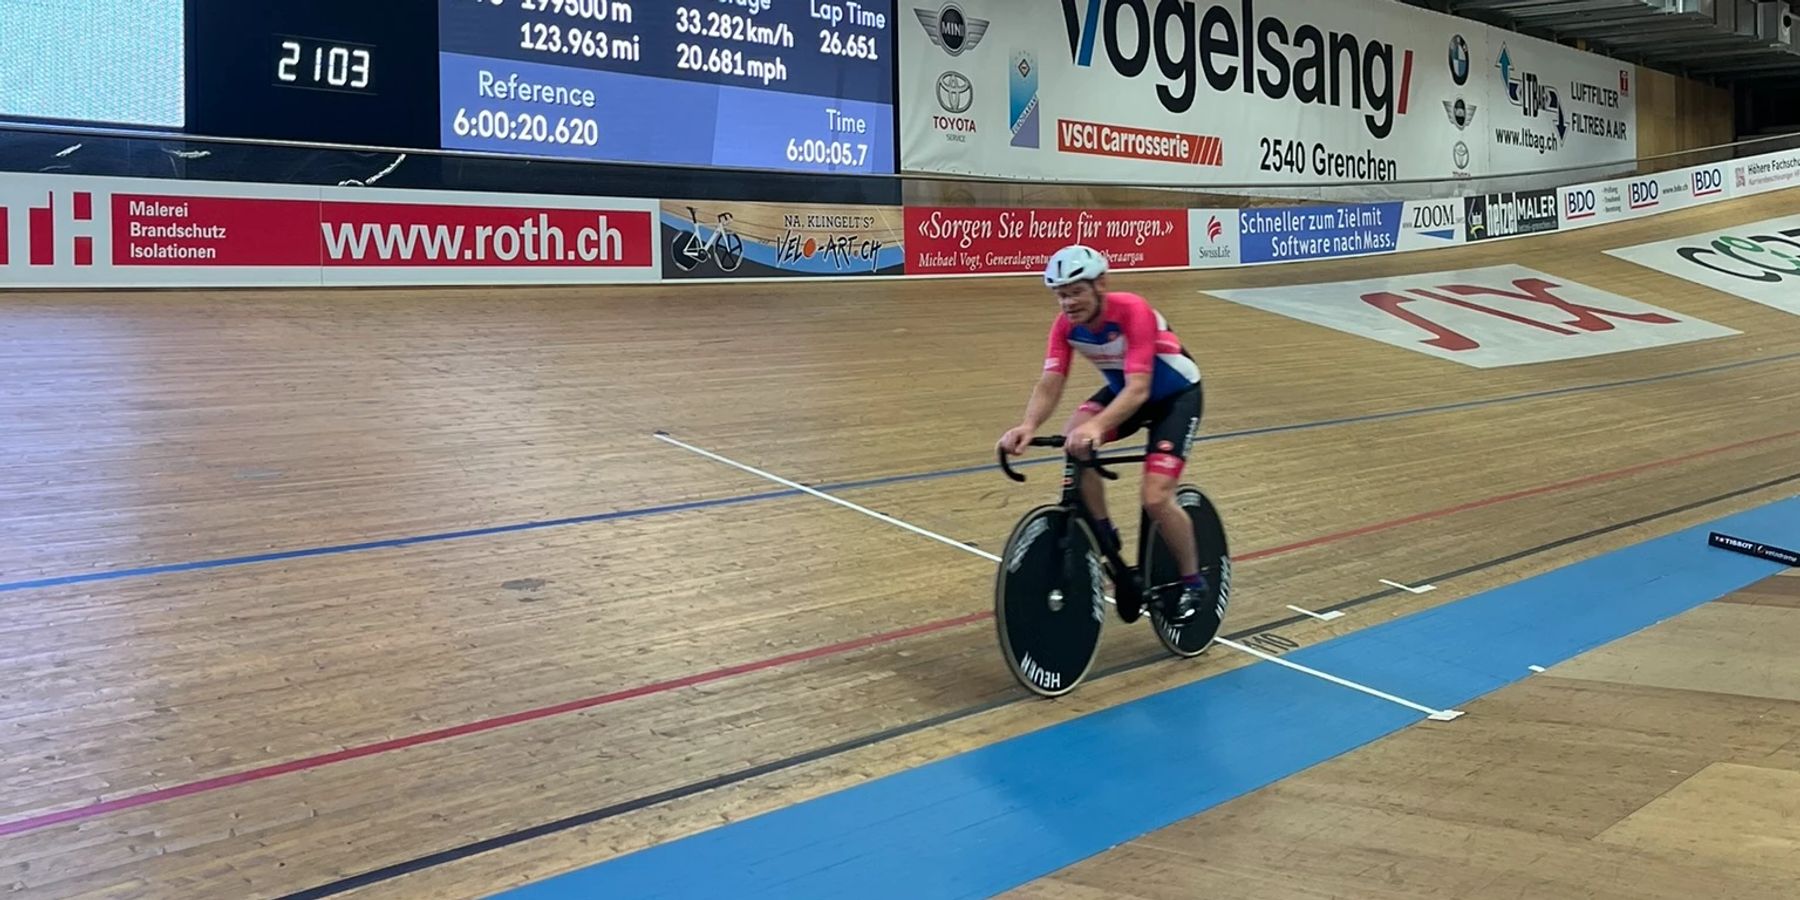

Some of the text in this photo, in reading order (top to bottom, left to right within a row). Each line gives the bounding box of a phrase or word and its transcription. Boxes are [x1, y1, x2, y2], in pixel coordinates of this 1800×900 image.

[612, 2, 632, 23] m
[810, 0, 886, 29] Lap Time
[676, 7, 744, 41] 33.282
[746, 18, 794, 48] km/h
[520, 22, 640, 62] 123.963 mi
[819, 29, 878, 60] 26.651
[278, 41, 370, 88] 2103
[676, 43, 787, 85] 20.681 mph
[1061, 0, 1395, 139] Vogelsang
[479, 70, 596, 107] Reference
[1570, 81, 1619, 109] LUFTFILTER
[453, 107, 598, 146] 6:00:20.620
[825, 108, 867, 133] Time
[933, 115, 977, 133] TOYOTA
[1571, 112, 1605, 137] FILTRES
[786, 138, 868, 166] 6:00:05.7
[1061, 122, 1189, 159] VSCI Carrosserie
[1495, 127, 1558, 154] www.ltbag.ch
[1260, 137, 1397, 181] 2540 Grenchen
[1631, 180, 1659, 203] BDO
[1695, 168, 1722, 191] BDO
[129, 201, 188, 217] Malerei
[1517, 195, 1556, 220] MALER
[1568, 189, 1595, 214] BDO
[918, 210, 1174, 248] «Sorgen Sie heute für morgen.»
[1241, 207, 1382, 234] Schneller zum Ziel mit
[1413, 204, 1455, 229] ZOOM
[130, 222, 226, 239] Brandschutz
[321, 213, 622, 261] www.roth.ch
[1272, 231, 1396, 257] Software nach Mass.
[130, 243, 216, 259] Isolationen
[918, 250, 1049, 271] Michael Vogt, Generalagentu
